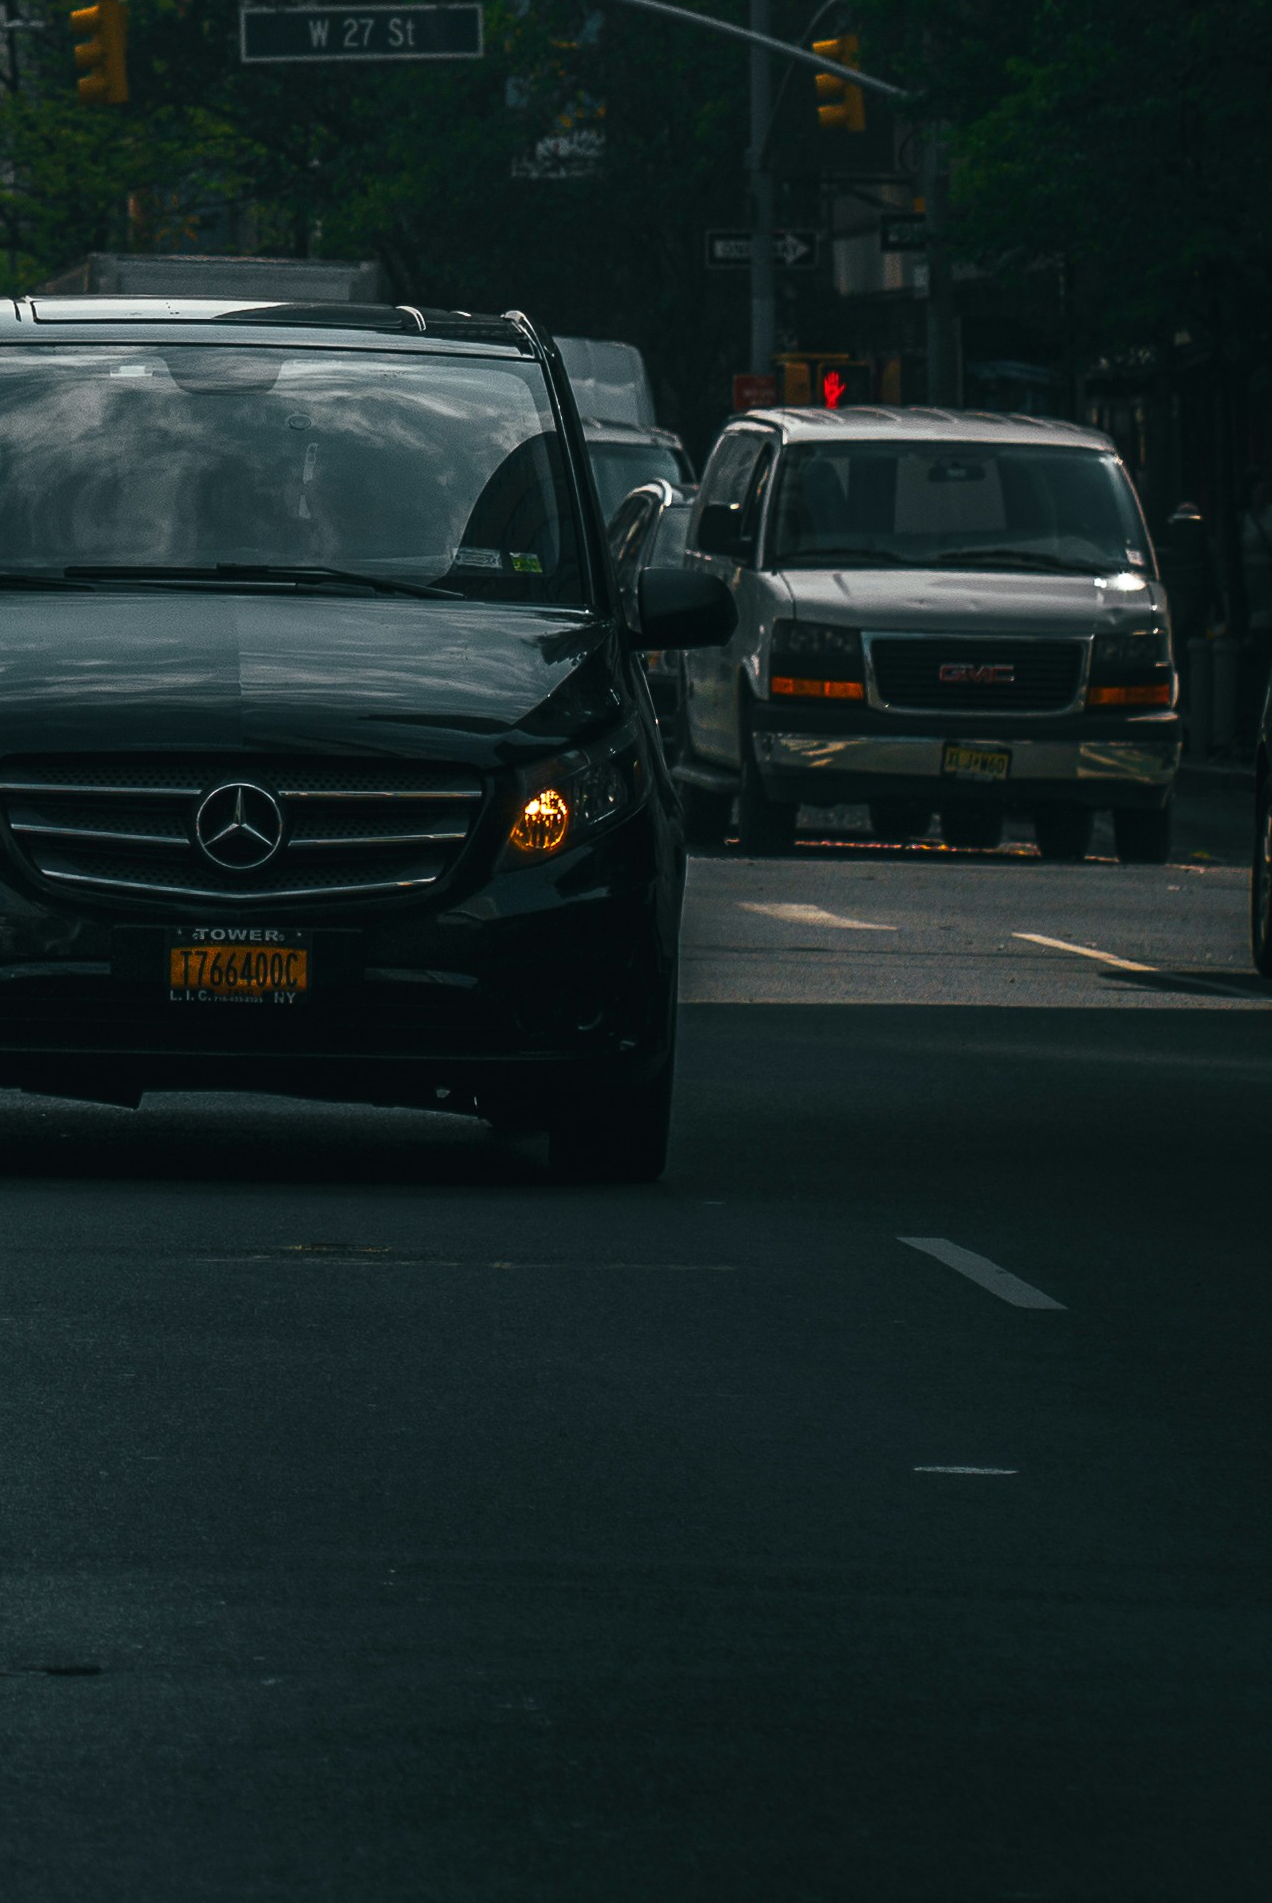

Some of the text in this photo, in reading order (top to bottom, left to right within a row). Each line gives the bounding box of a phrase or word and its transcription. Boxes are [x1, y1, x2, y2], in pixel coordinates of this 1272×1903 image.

[309, 18, 415, 48] W 27 St
[938, 663, 1016, 683] GMC
[195, 928, 279, 942] TOWER
[180, 951, 298, 989] T766400C
[273, 991, 297, 1004] NY
